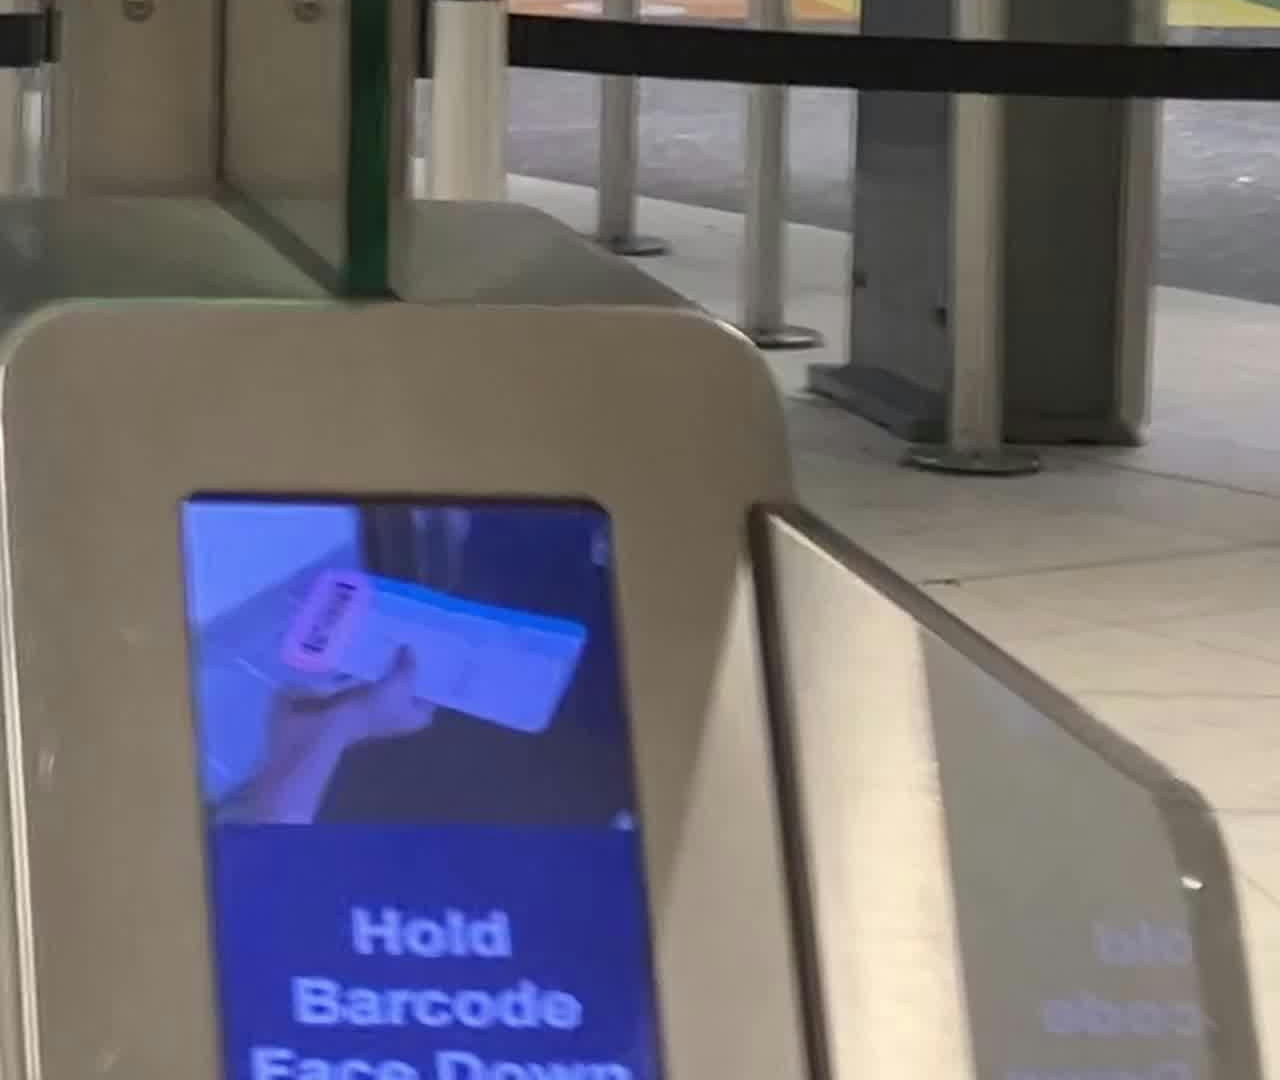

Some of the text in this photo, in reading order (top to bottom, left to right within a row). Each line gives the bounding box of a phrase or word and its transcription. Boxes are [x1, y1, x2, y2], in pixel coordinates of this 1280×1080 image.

[351, 905, 513, 959] Hold
[290, 975, 583, 1030] Barcode
[250, 1044, 420, 1080] Face
